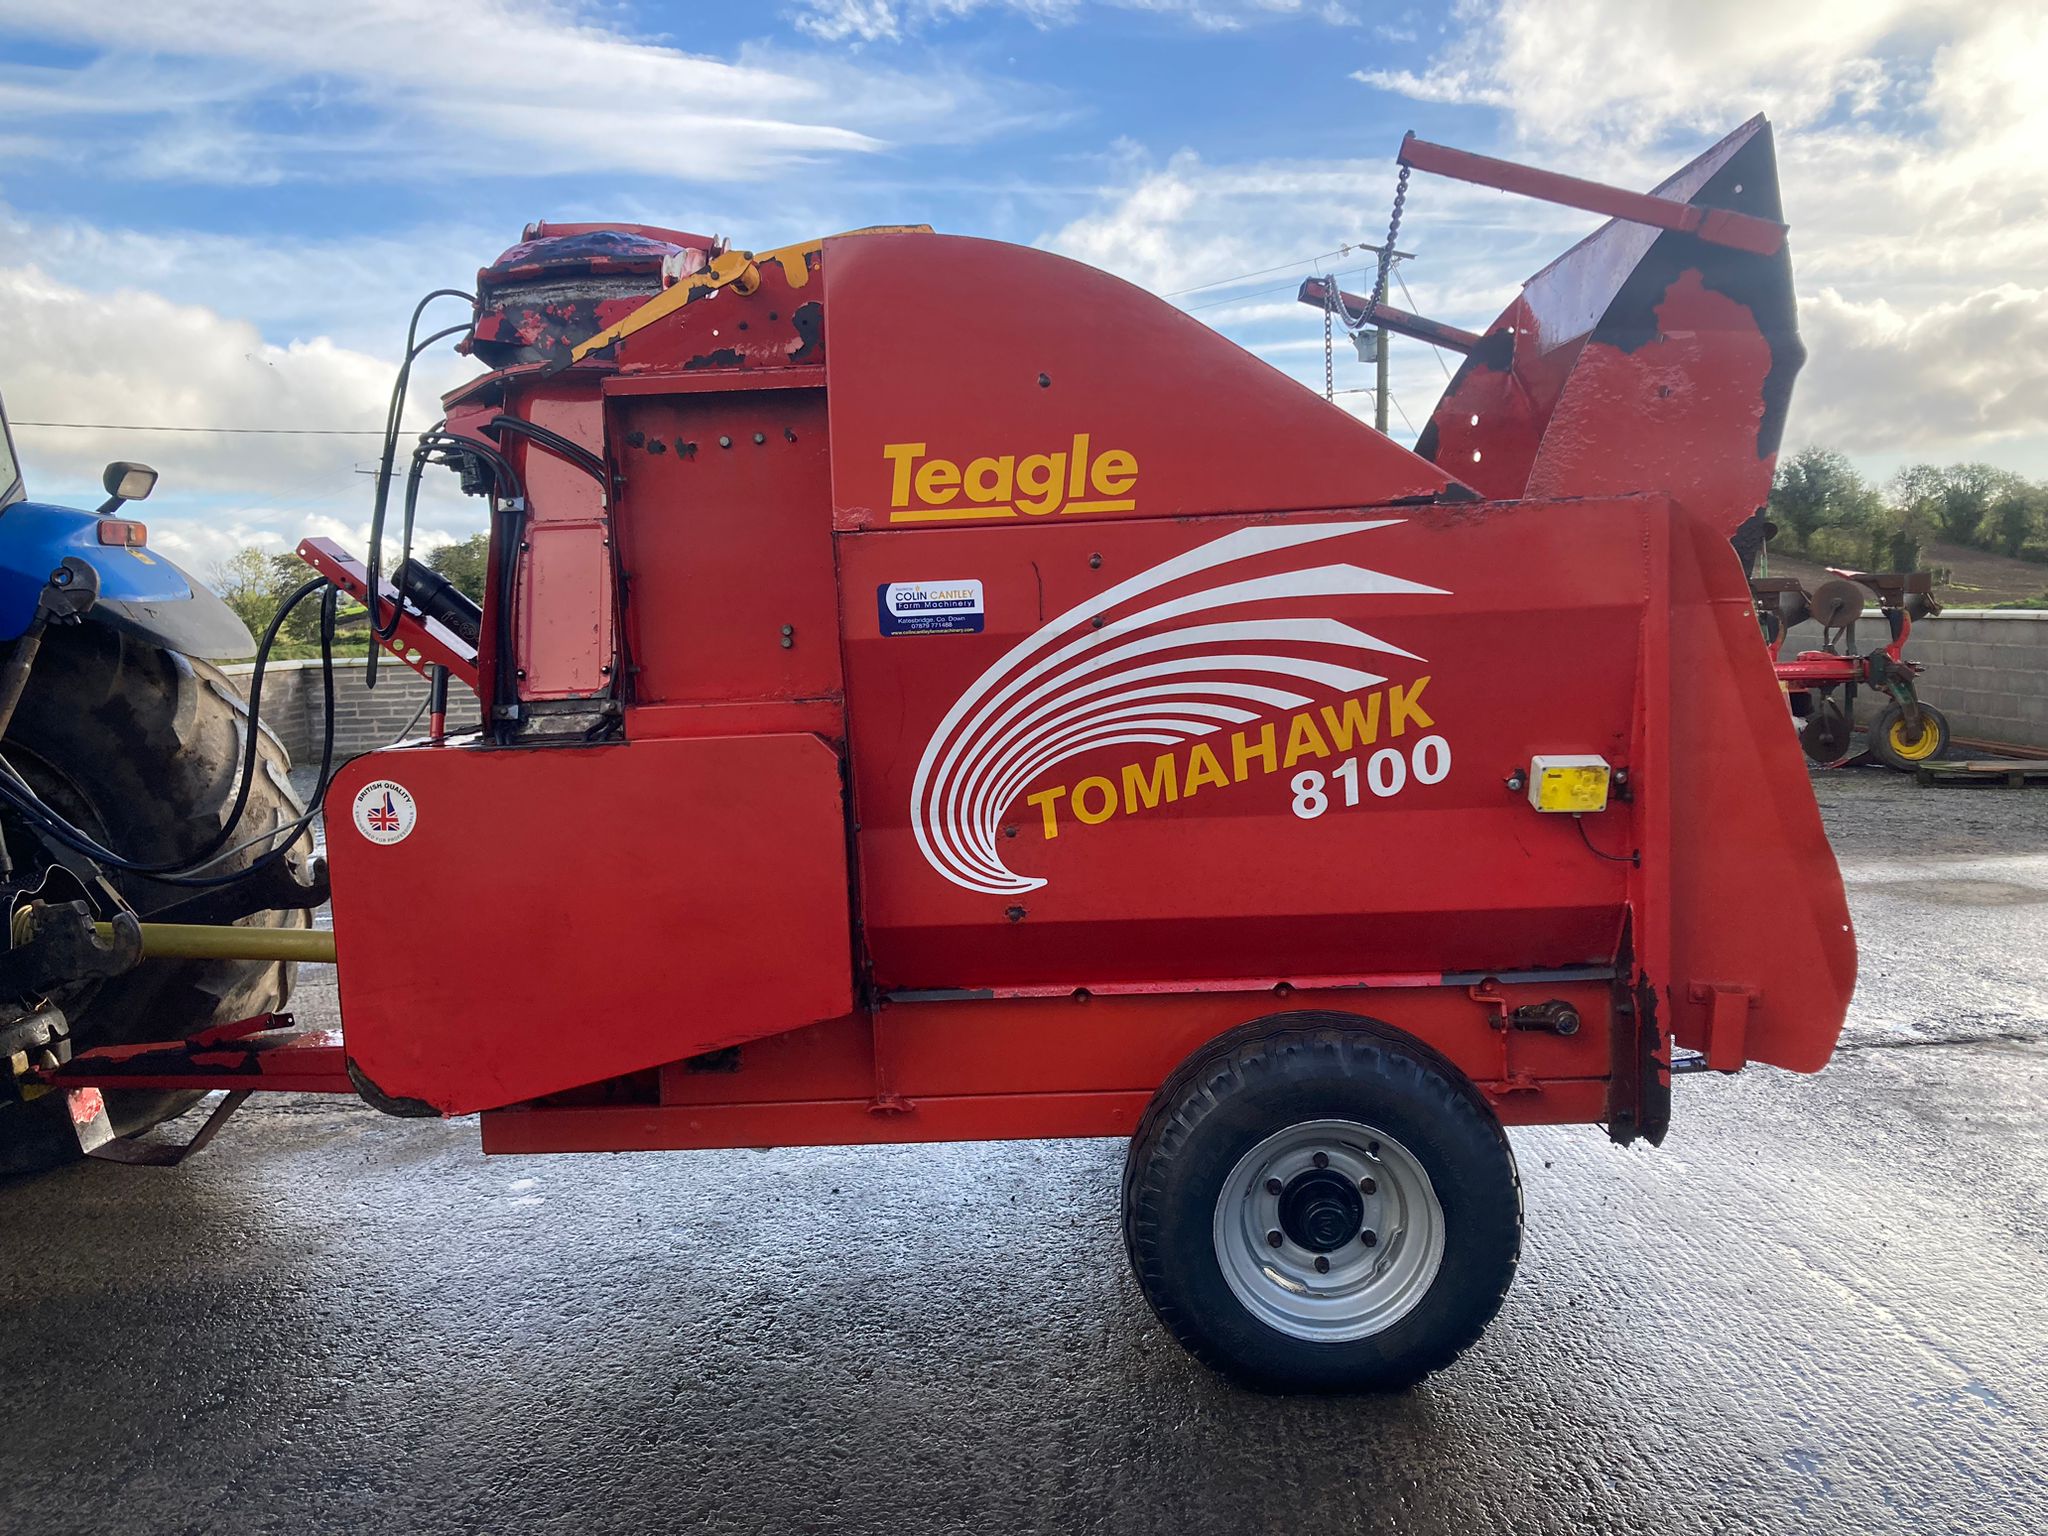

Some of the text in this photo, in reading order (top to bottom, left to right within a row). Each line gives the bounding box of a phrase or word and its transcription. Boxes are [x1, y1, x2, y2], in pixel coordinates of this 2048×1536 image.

[883, 433, 1139, 515] Teagle
[895, 589, 974, 601] COLIN CANTLEY
[924, 600, 972, 608] Machinery
[1027, 675, 1435, 840] TOMAHAWK
[1290, 735, 1452, 820] 8100
[357, 782, 411, 803] BRITISH QUALITY
